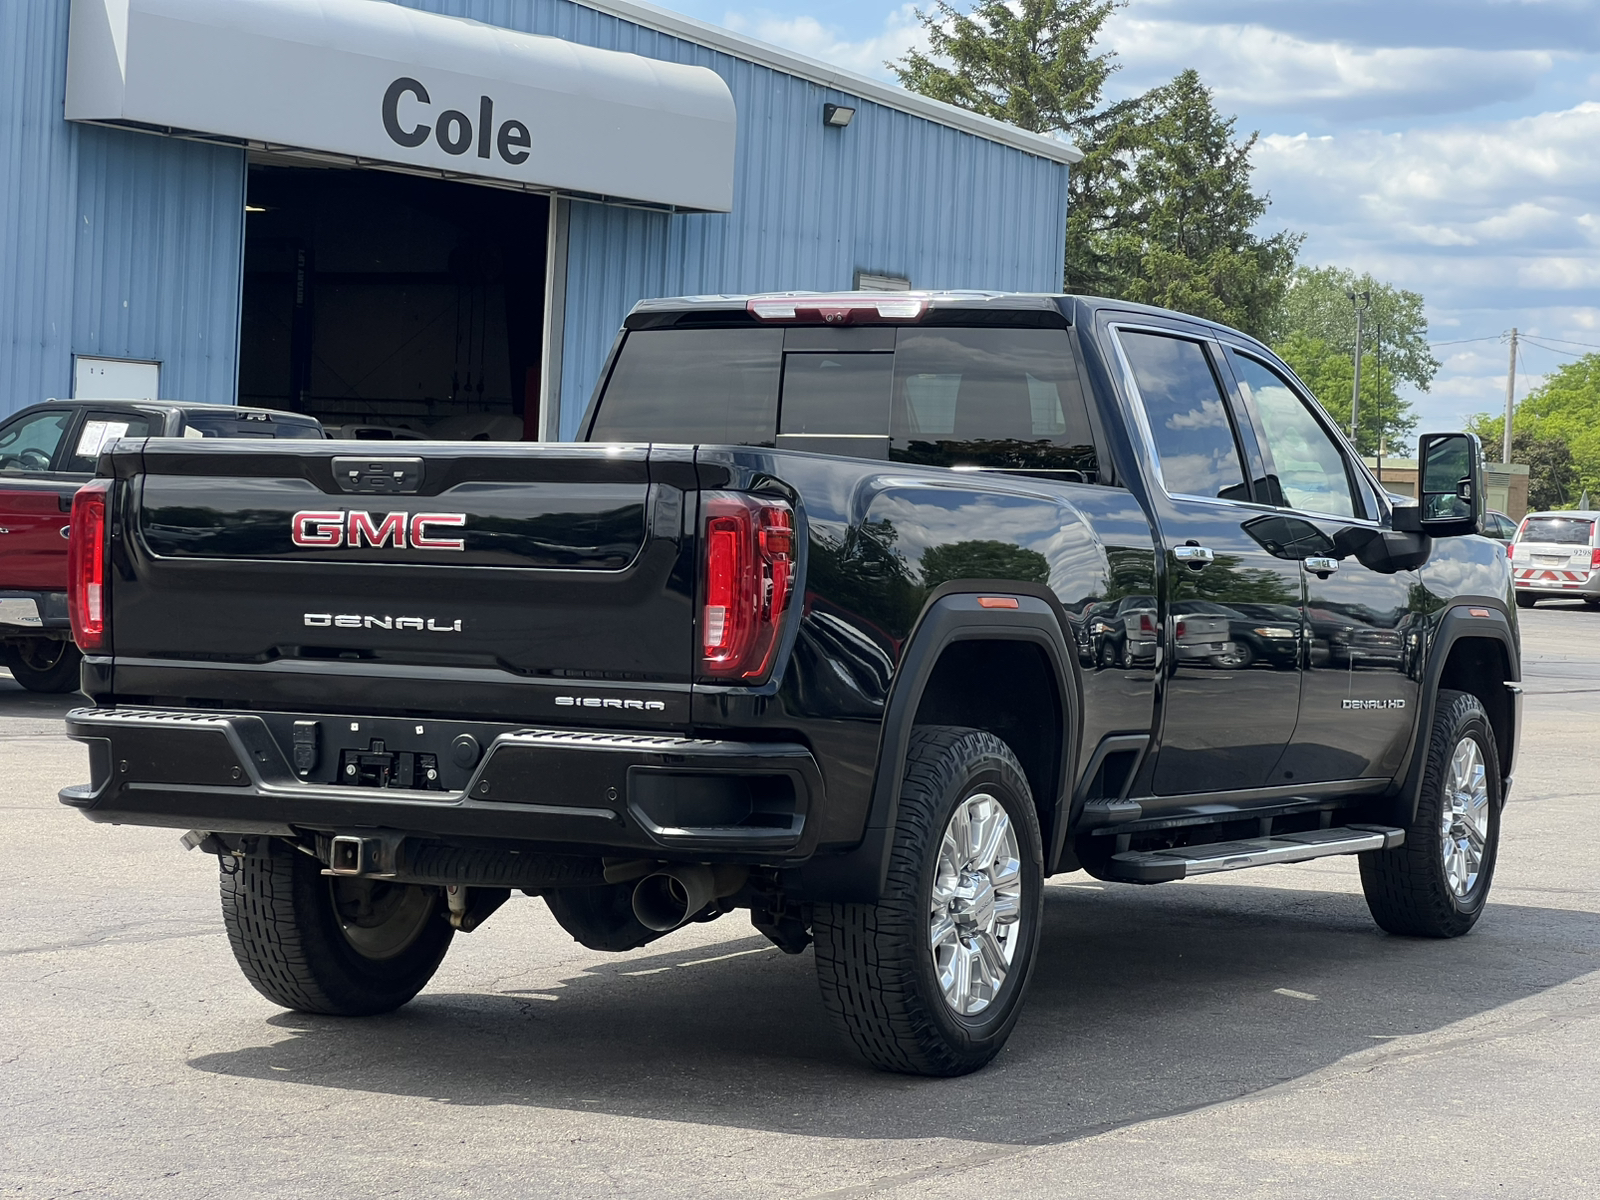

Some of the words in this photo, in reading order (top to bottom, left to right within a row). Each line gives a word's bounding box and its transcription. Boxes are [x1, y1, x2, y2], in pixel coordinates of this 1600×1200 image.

[382, 77, 531, 165] Cole
[291, 511, 466, 551] GMC
[304, 613, 462, 632] DENALI
[555, 696, 665, 711] SIERRA
[1342, 699, 1387, 709] DENALI
[1388, 699, 1406, 709] HD
